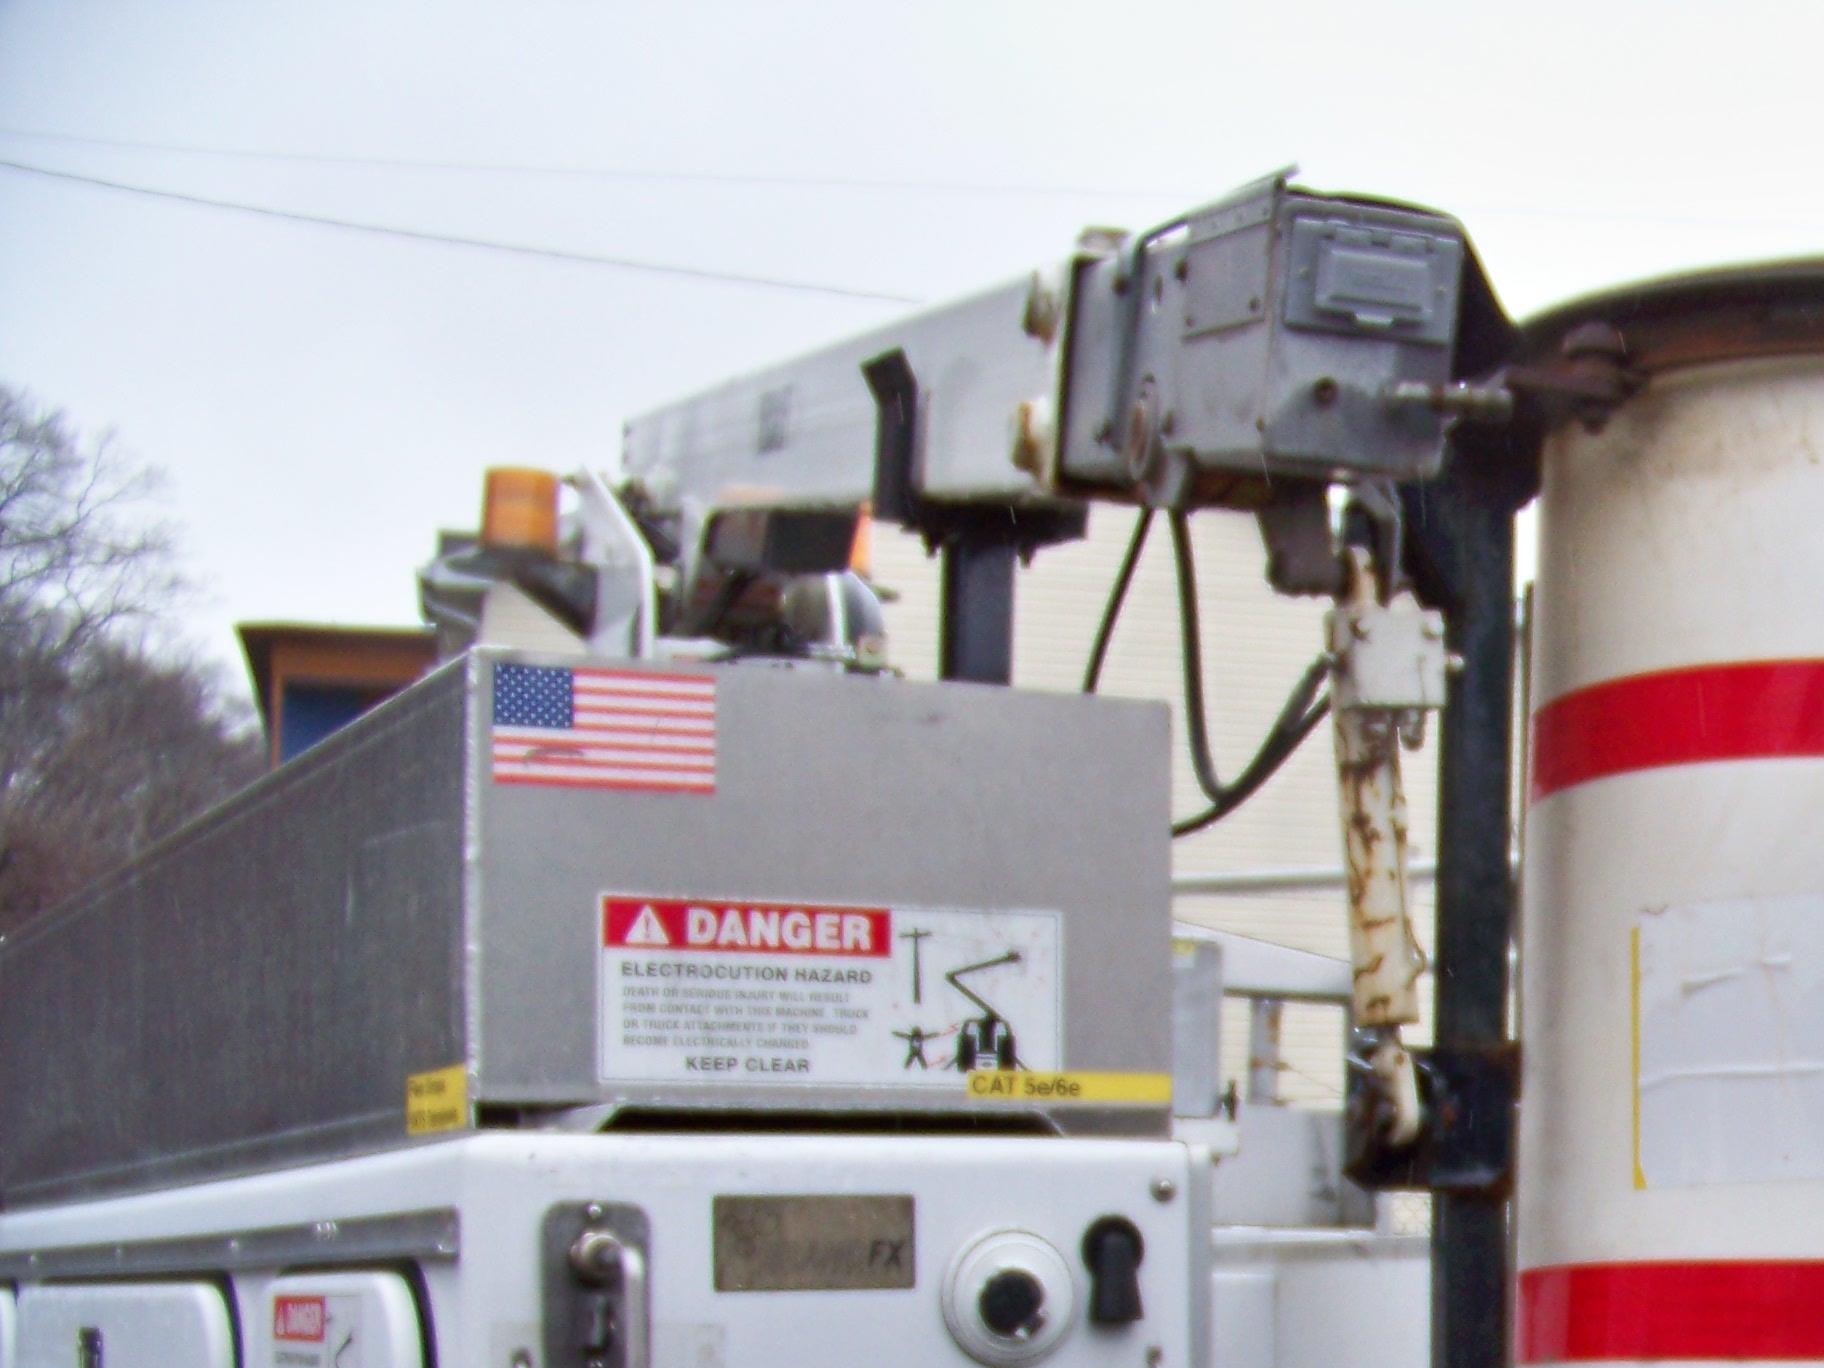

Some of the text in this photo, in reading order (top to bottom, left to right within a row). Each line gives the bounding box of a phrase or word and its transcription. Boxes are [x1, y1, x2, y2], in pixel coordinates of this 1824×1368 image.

[686, 907, 872, 951] DANGER
[621, 960, 873, 985] ELECTROCUTION HAZARD
[685, 1056, 810, 1073] KEEP CLEAR
[972, 1075, 1082, 1097] CAT 5e/6e
